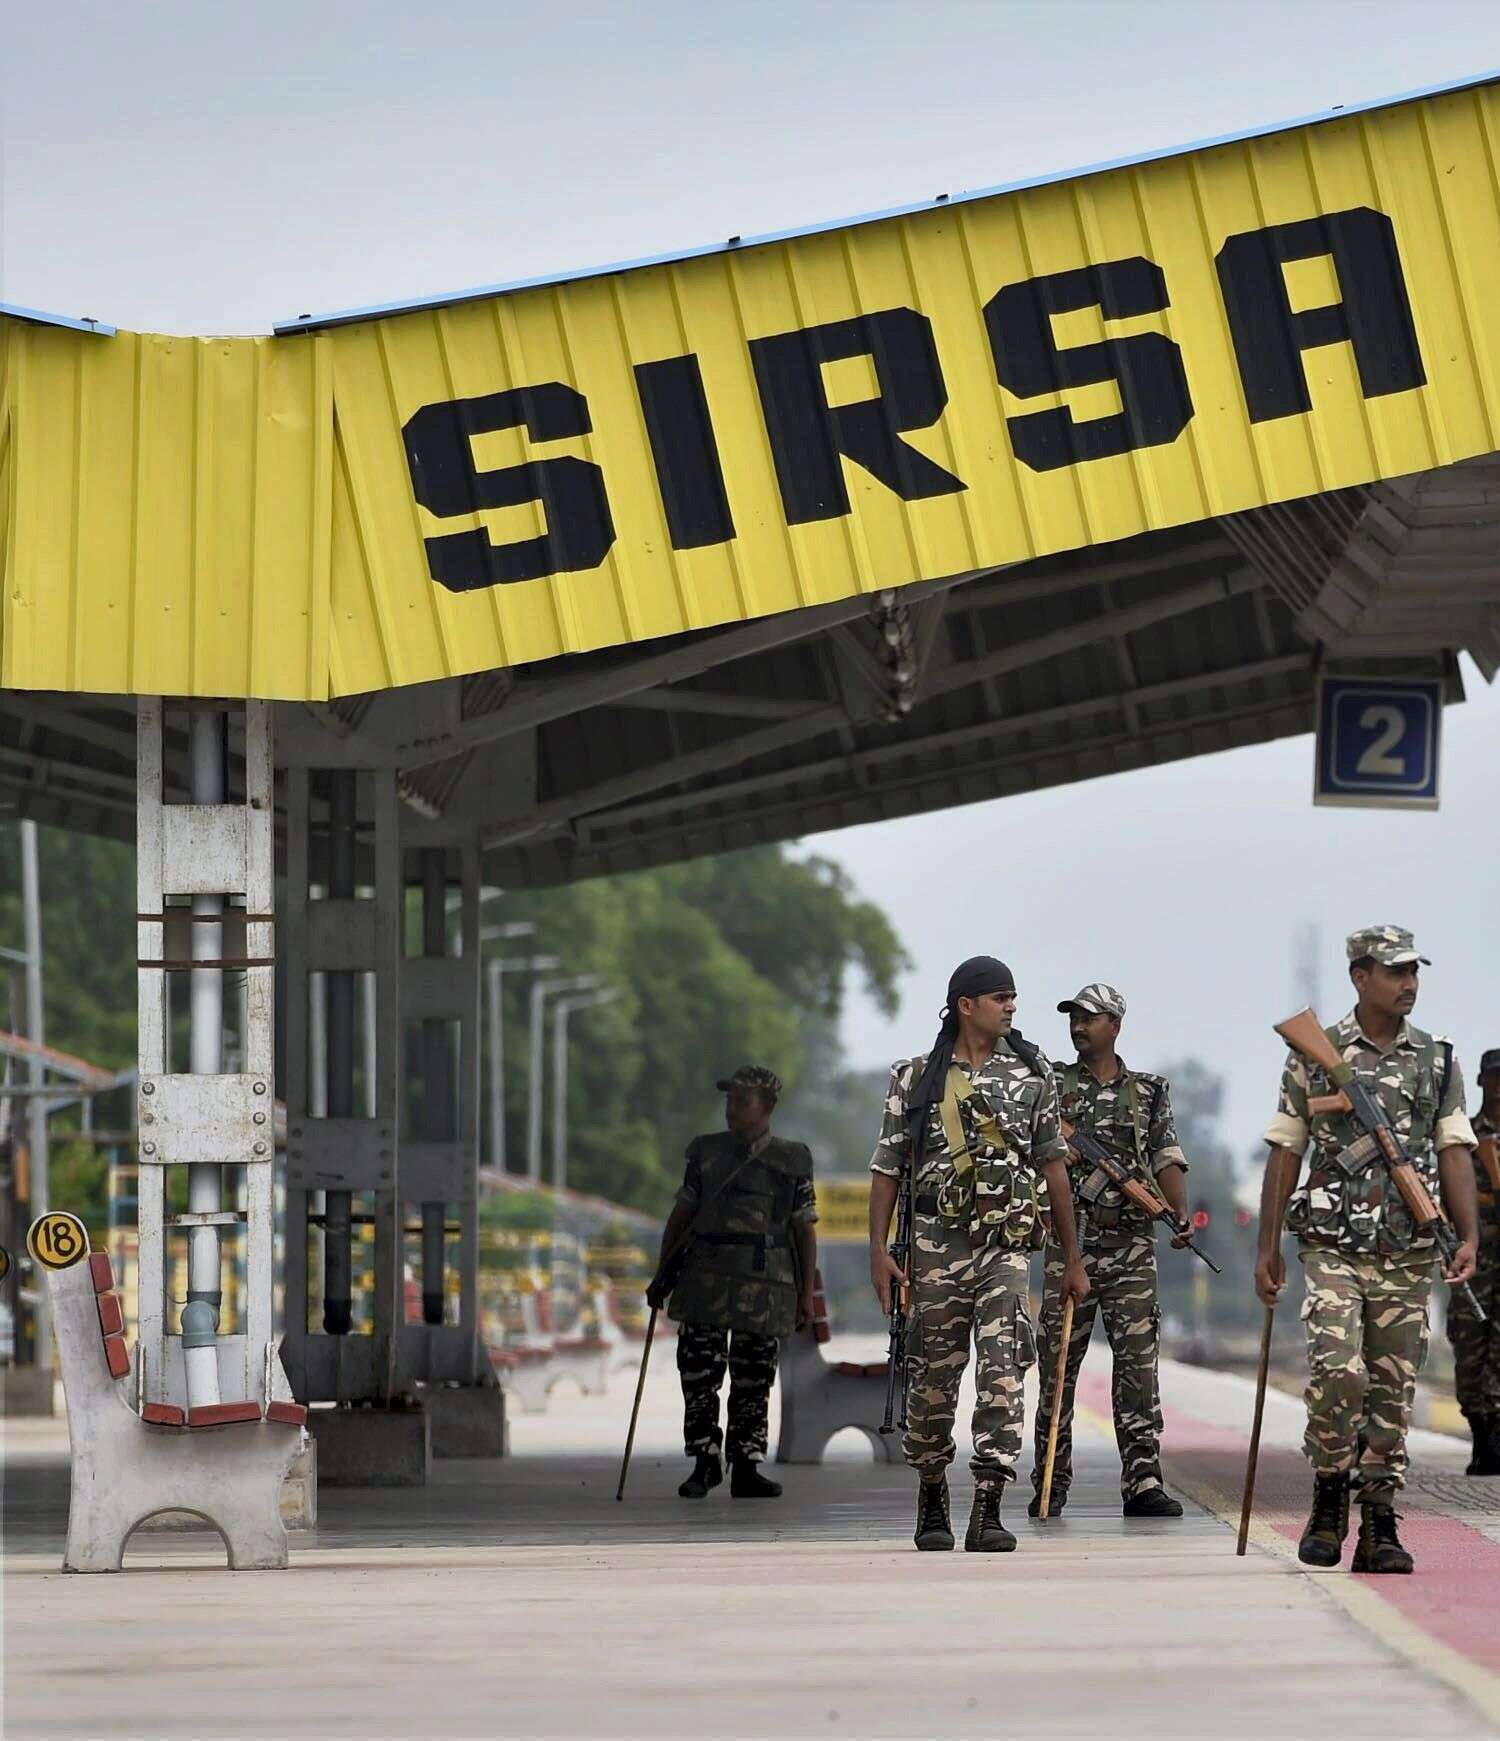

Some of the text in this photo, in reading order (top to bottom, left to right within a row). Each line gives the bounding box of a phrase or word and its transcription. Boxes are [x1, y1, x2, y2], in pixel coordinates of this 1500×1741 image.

[401, 206, 1428, 593] SIRSA
[1357, 705, 1406, 776] 2
[43, 1221, 76, 1257] 18
